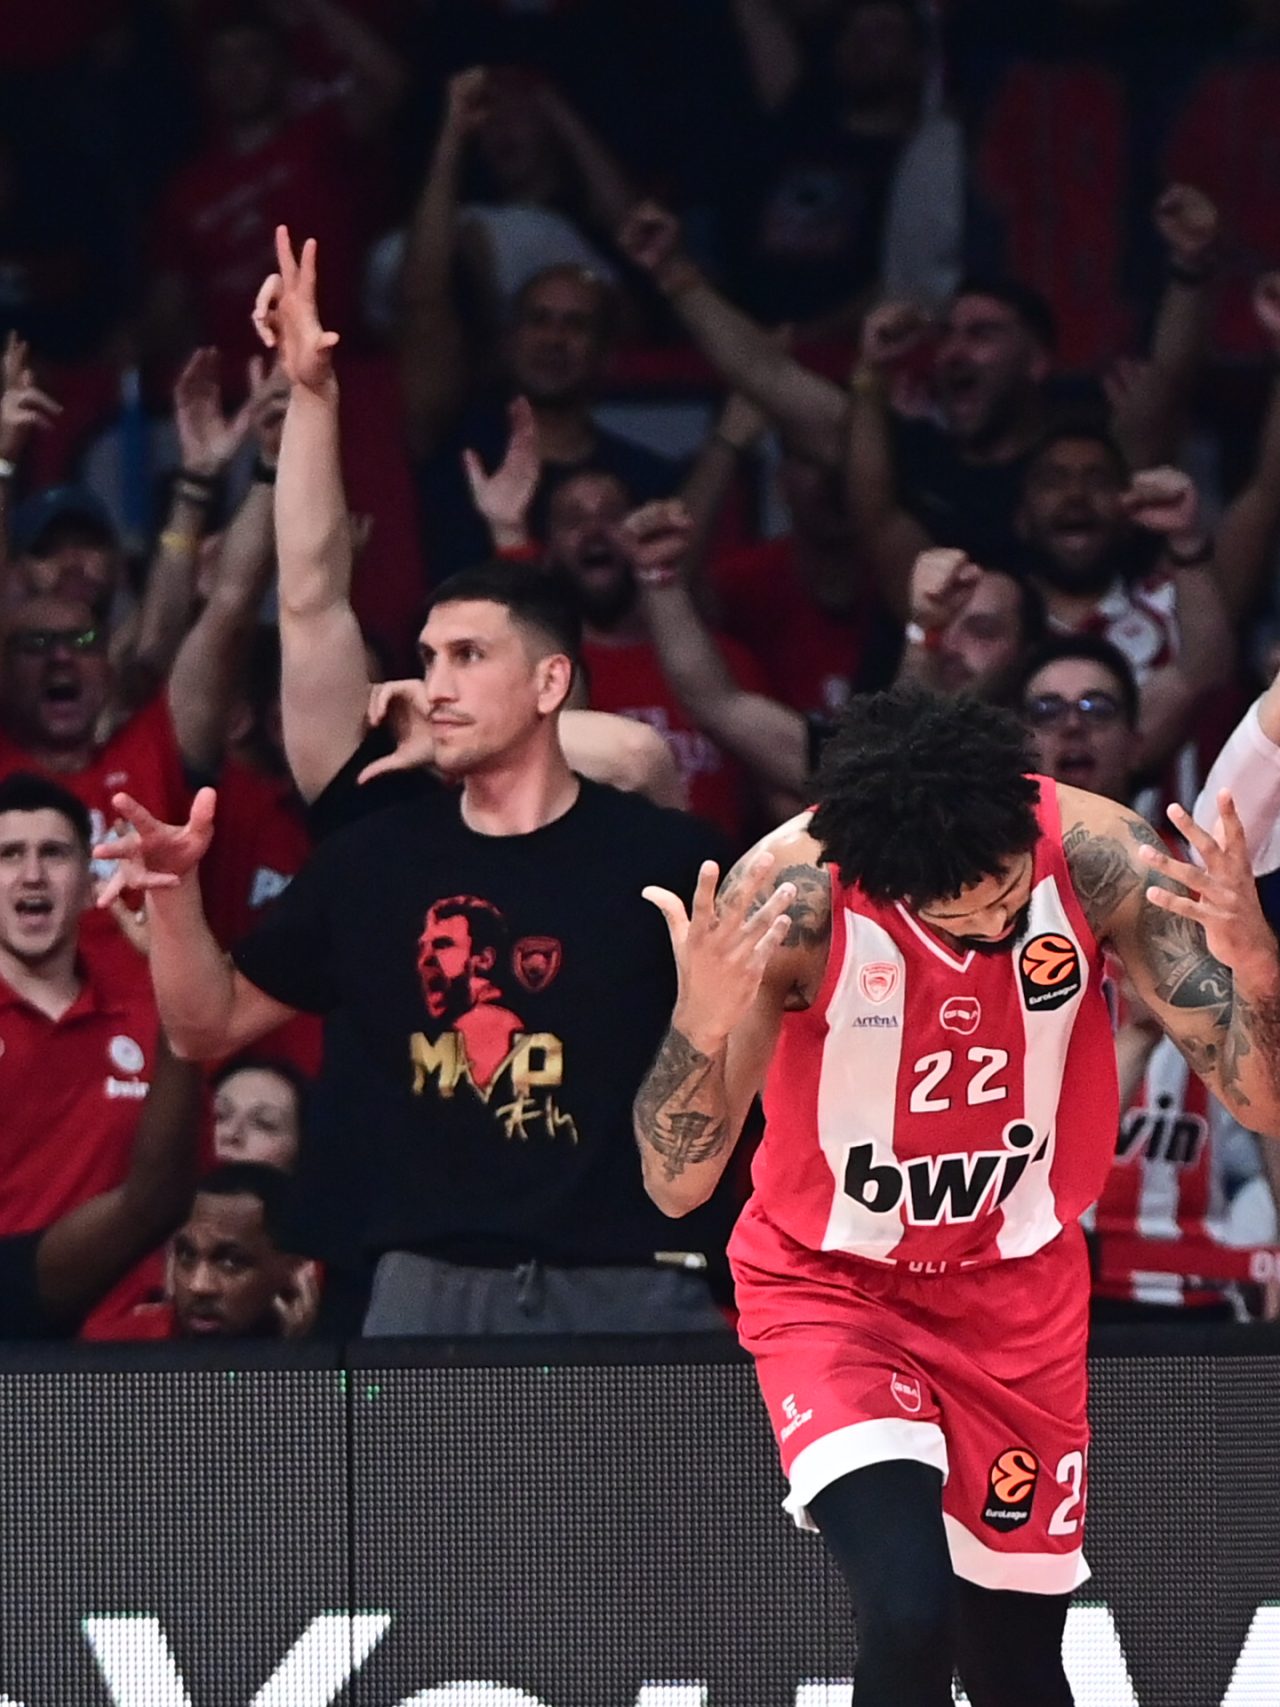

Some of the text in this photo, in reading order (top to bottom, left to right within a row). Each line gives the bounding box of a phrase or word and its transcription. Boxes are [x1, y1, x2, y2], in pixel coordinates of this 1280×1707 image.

[1029, 984, 1078, 1005] EuroLeague
[909, 1046, 1009, 1113] 22
[843, 1122, 1051, 1221] bwi
[985, 1508, 1027, 1520] EuroLeague
[1048, 1443, 1089, 1536] 2
